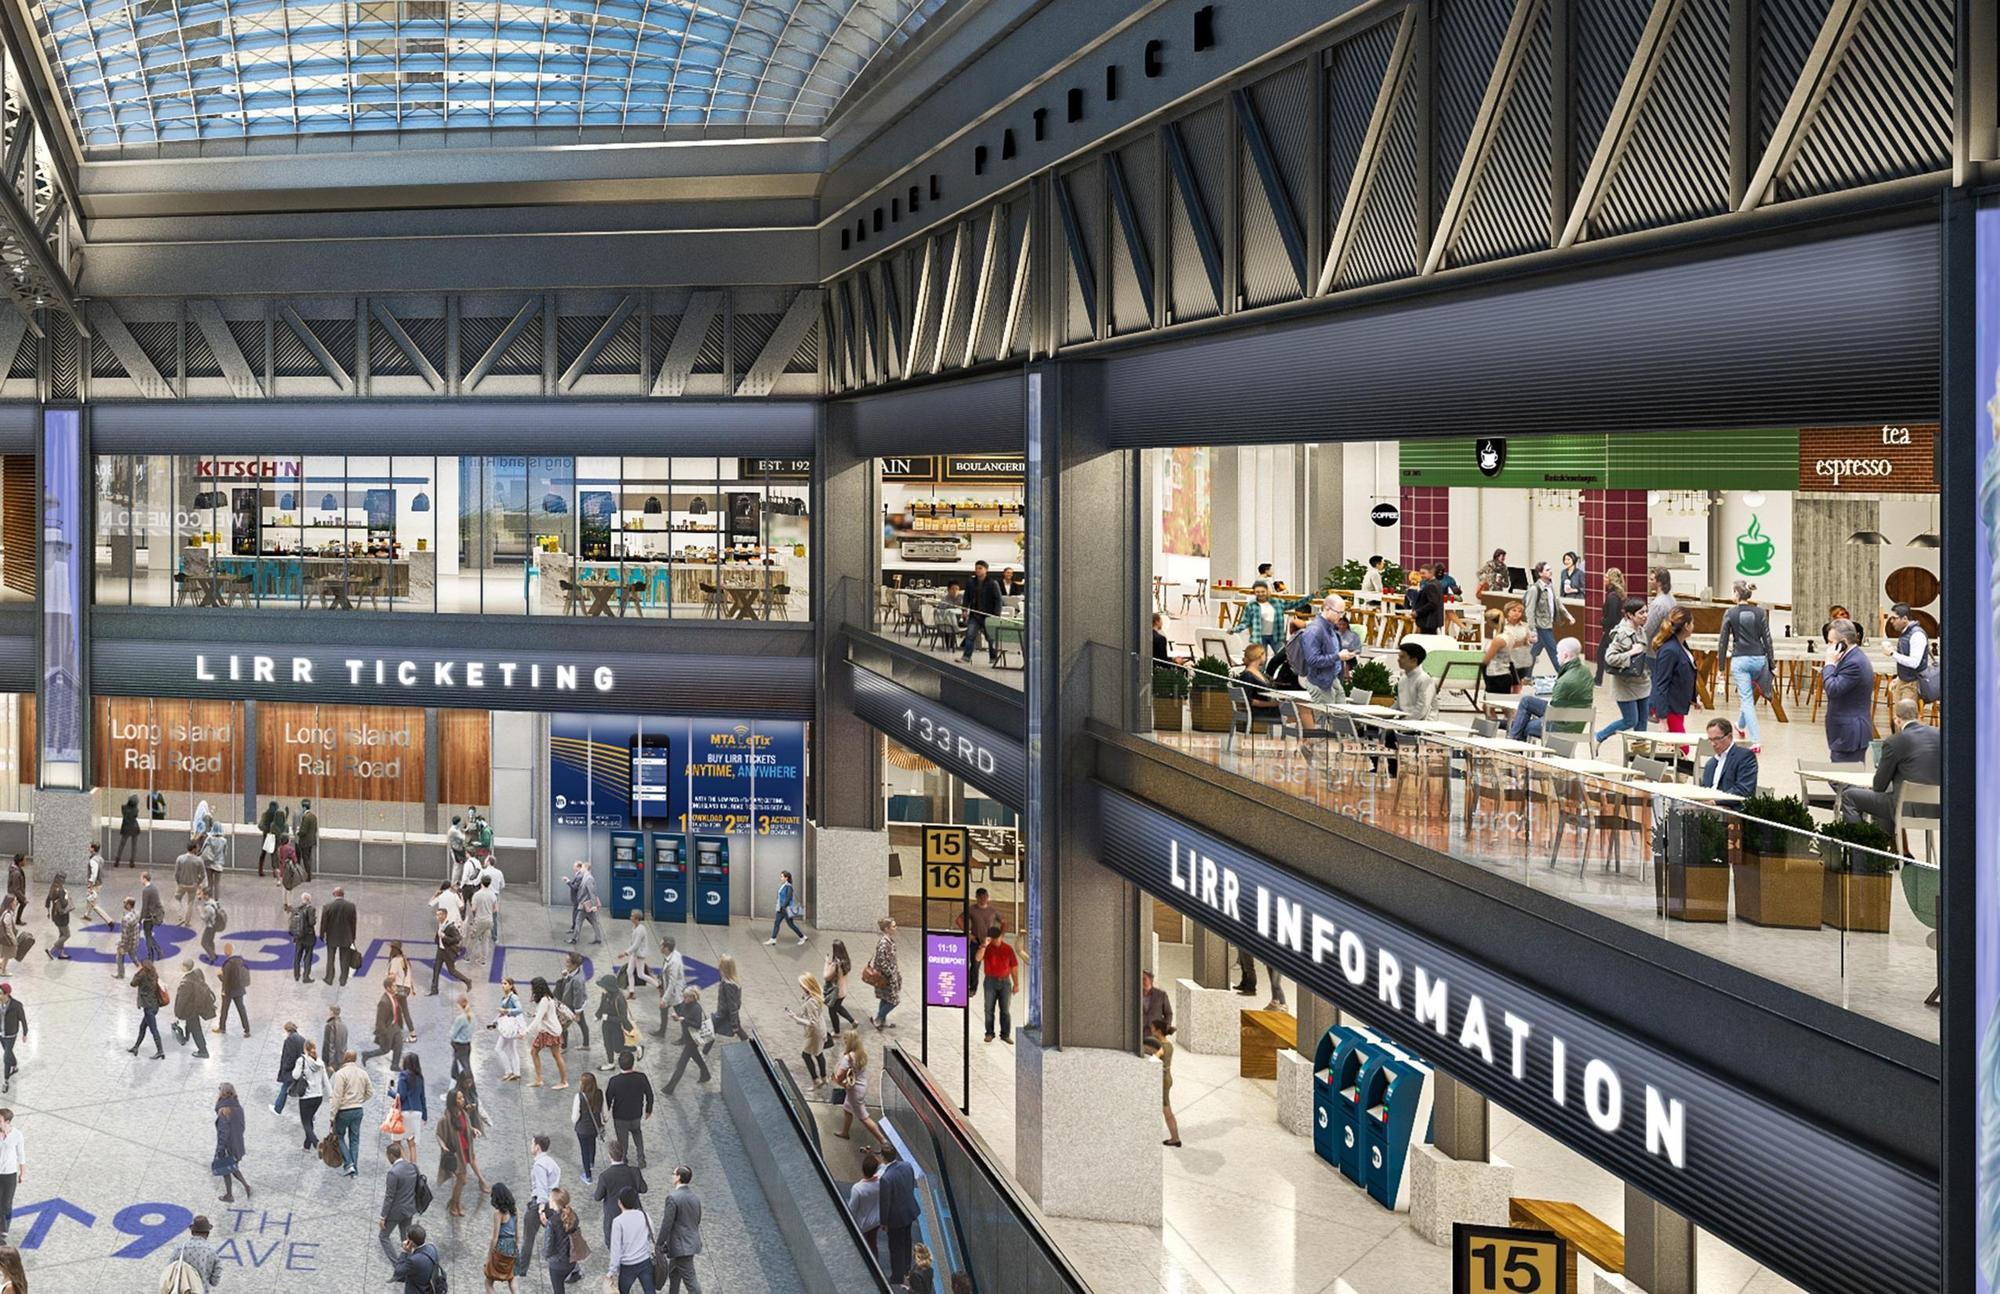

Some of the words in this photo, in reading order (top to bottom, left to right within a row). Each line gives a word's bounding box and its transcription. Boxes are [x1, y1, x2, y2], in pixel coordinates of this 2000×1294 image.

[1882, 425, 1911, 445] tea
[197, 461, 301, 477] KITSCH'N
[759, 461, 785, 471] EST.
[791, 461, 810, 471] 192
[881, 459, 911, 474] AIN
[956, 462, 1025, 472] BOULANGERI
[1816, 459, 1892, 486] espresso
[1371, 511, 1399, 519] COFFEE
[195, 655, 314, 683] LIRR
[345, 659, 614, 691] TICKETING
[112, 719, 161, 746] Long
[168, 720, 231, 743] Island
[285, 722, 336, 750] Long
[343, 722, 411, 747] Island
[710, 734, 735, 745] MTA
[919, 716, 996, 775] 33RD
[125, 748, 161, 770] Rail
[168, 750, 222, 773] Road
[298, 753, 336, 776] Rail
[343, 755, 401, 778] Road
[707, 754, 723, 763] BUY
[725, 755, 742, 763] LIRR
[744, 755, 776, 765] TICKETS
[685, 764, 735, 779] ANYTIME,
[737, 765, 797, 779] ANYWHERE
[679, 814, 687, 833] 1
[692, 815, 723, 823] OWNLOAD
[725, 815, 736, 834] 2
[758, 815, 770, 835] 3
[930, 832, 961, 856] 15
[929, 866, 961, 889] 16
[937, 943, 958, 954] 11:10
[1170, 838, 1240, 922] LIRR
[1257, 885, 1684, 1169] INFORMATION
[111, 1202, 194, 1260] 9
[227, 1208, 293, 1235] TH
[216, 1238, 321, 1271] AVE
[1471, 1243, 1543, 1294] 15
